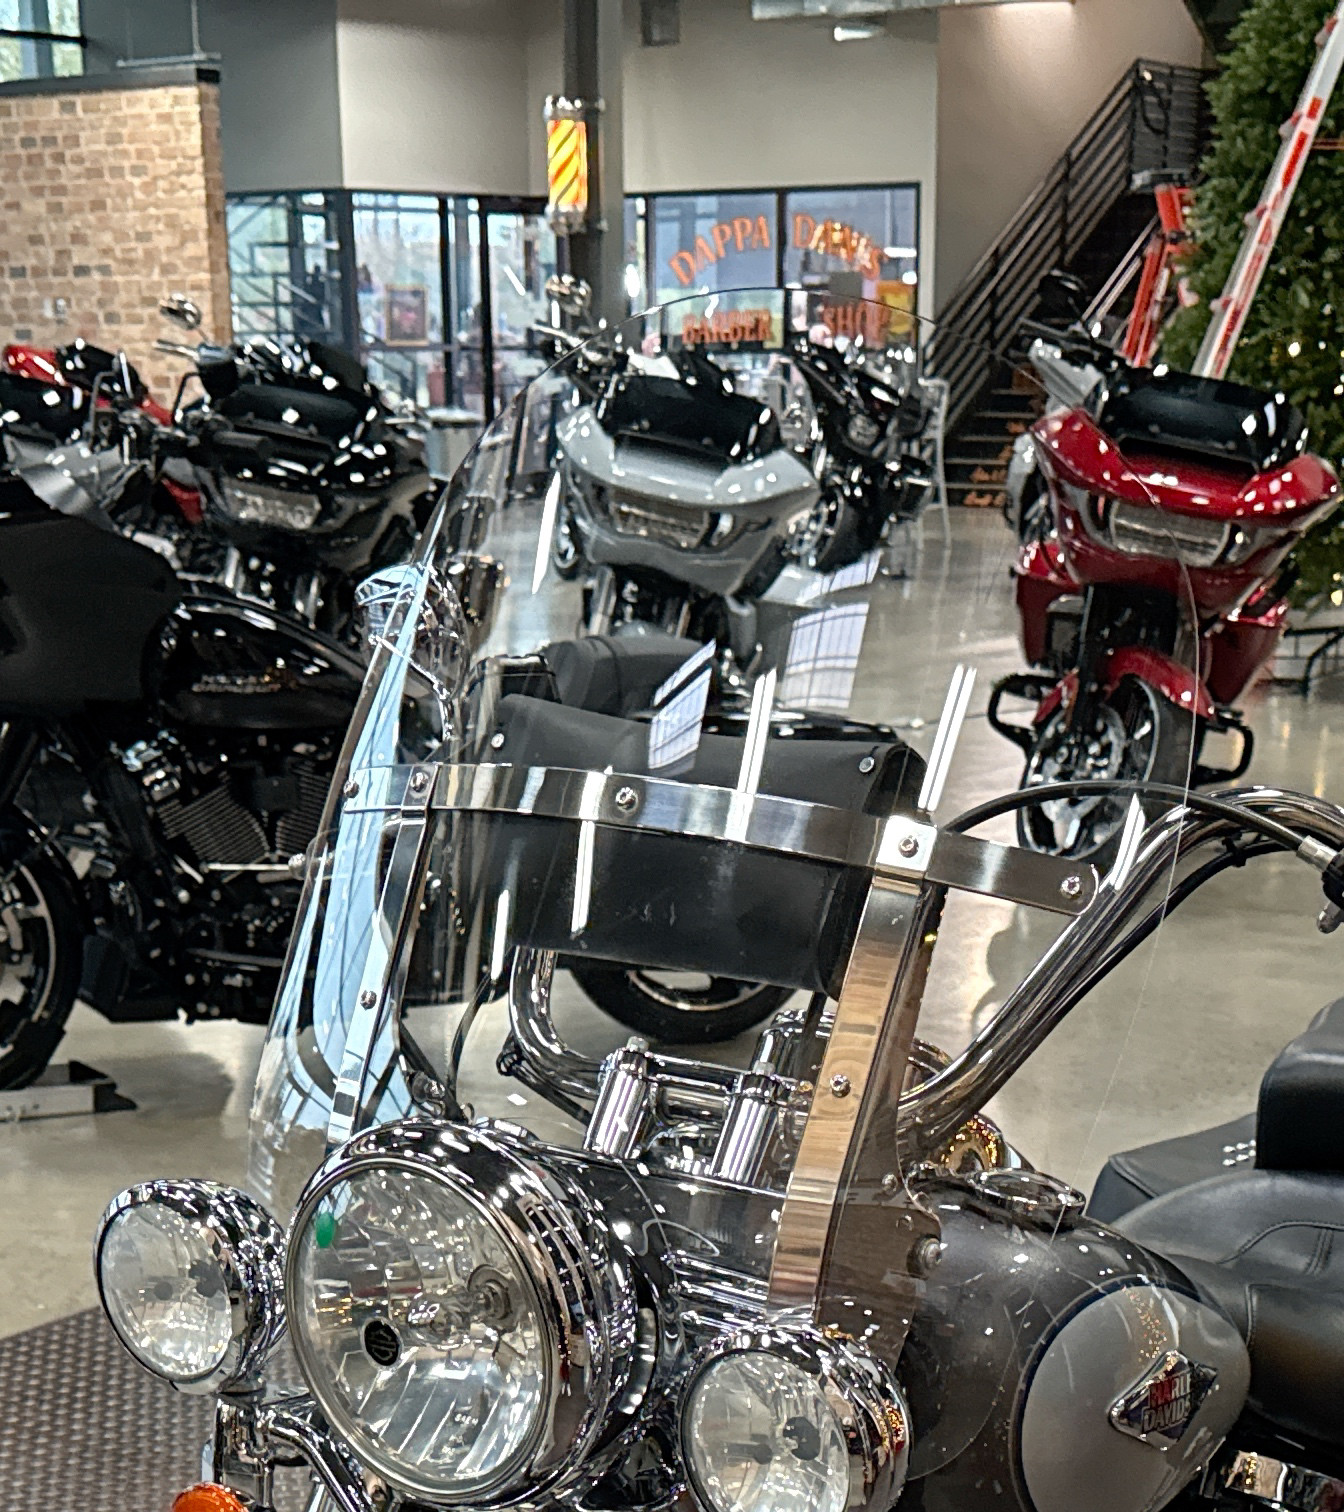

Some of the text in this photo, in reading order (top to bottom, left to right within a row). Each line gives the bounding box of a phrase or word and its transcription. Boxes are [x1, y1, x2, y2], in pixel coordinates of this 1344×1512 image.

[668, 214, 771, 286] DAPPA
[682, 300, 893, 348] BARBER SHOP
